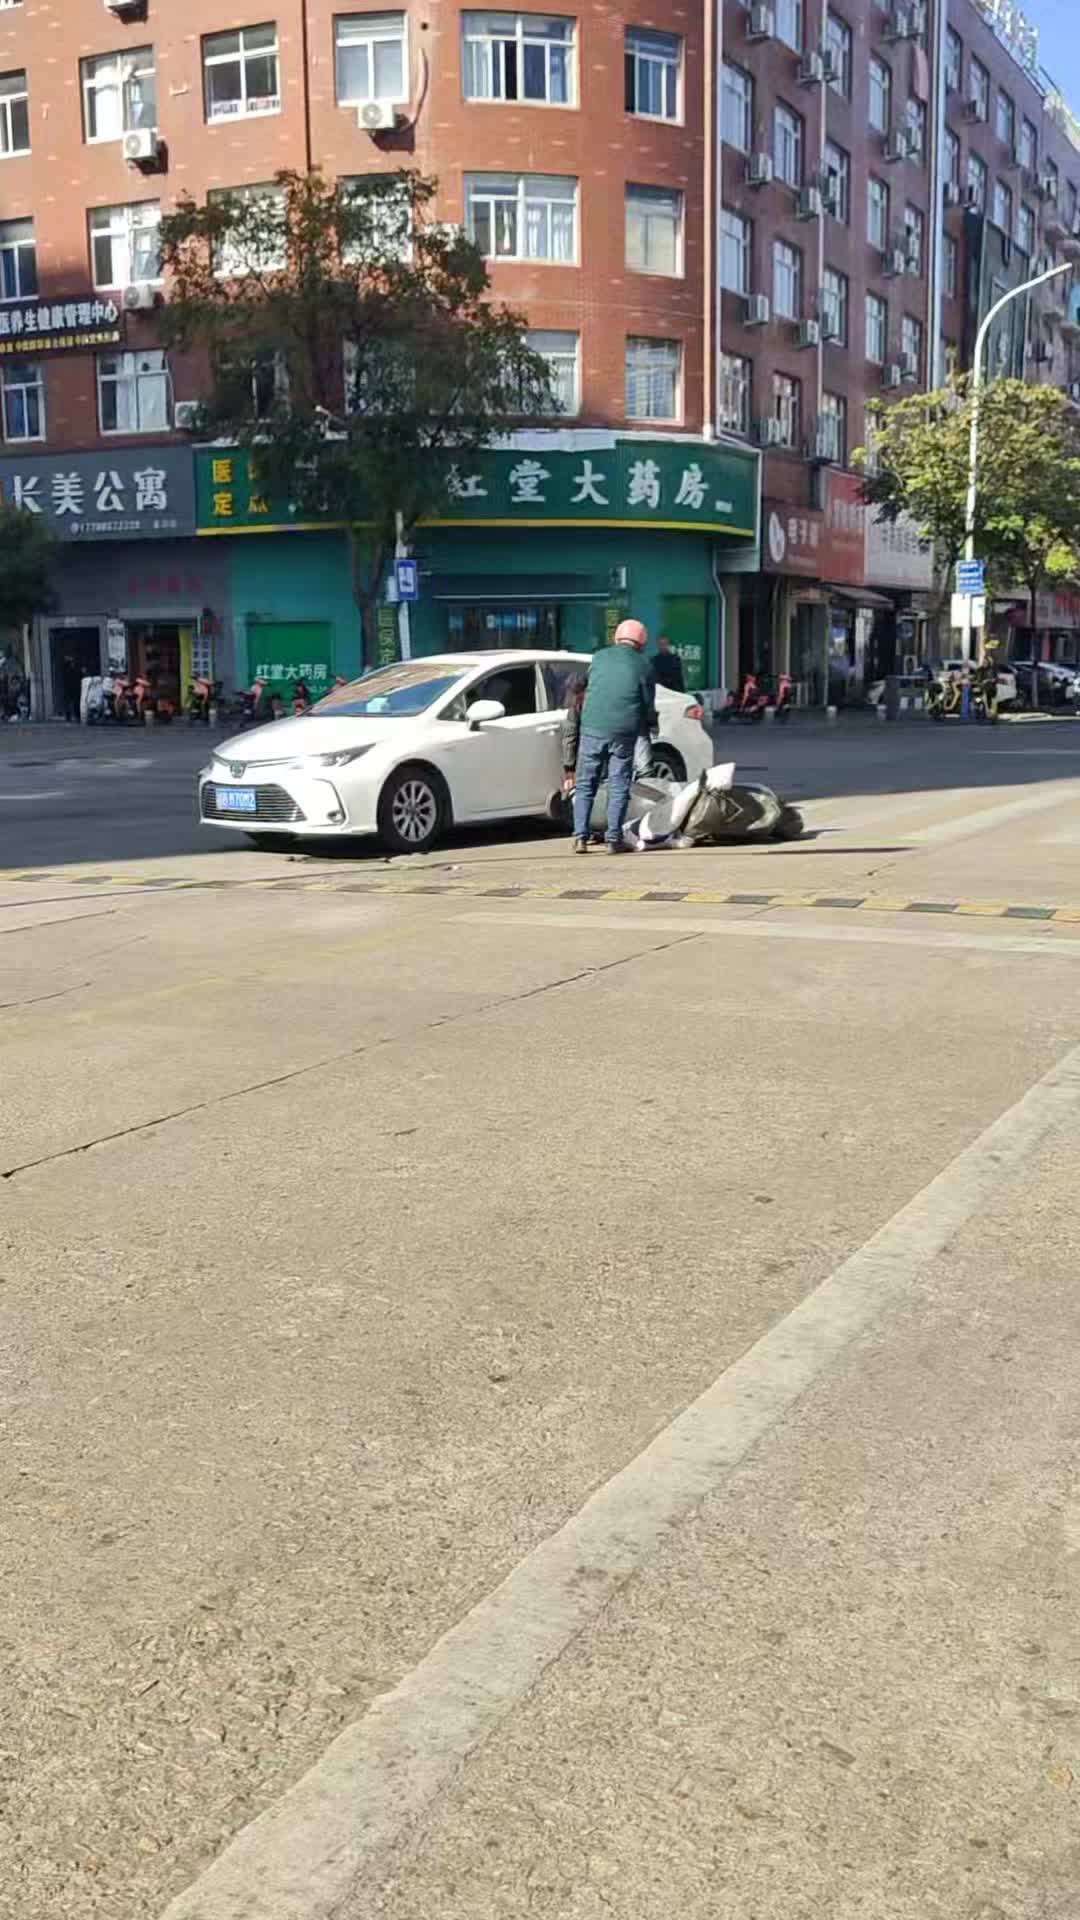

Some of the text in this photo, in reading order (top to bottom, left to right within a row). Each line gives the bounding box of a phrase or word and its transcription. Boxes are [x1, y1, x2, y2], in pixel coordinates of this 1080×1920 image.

[12, 467, 167, 515] 长美公寓
[255, 663, 327, 681] 红堂大药房
